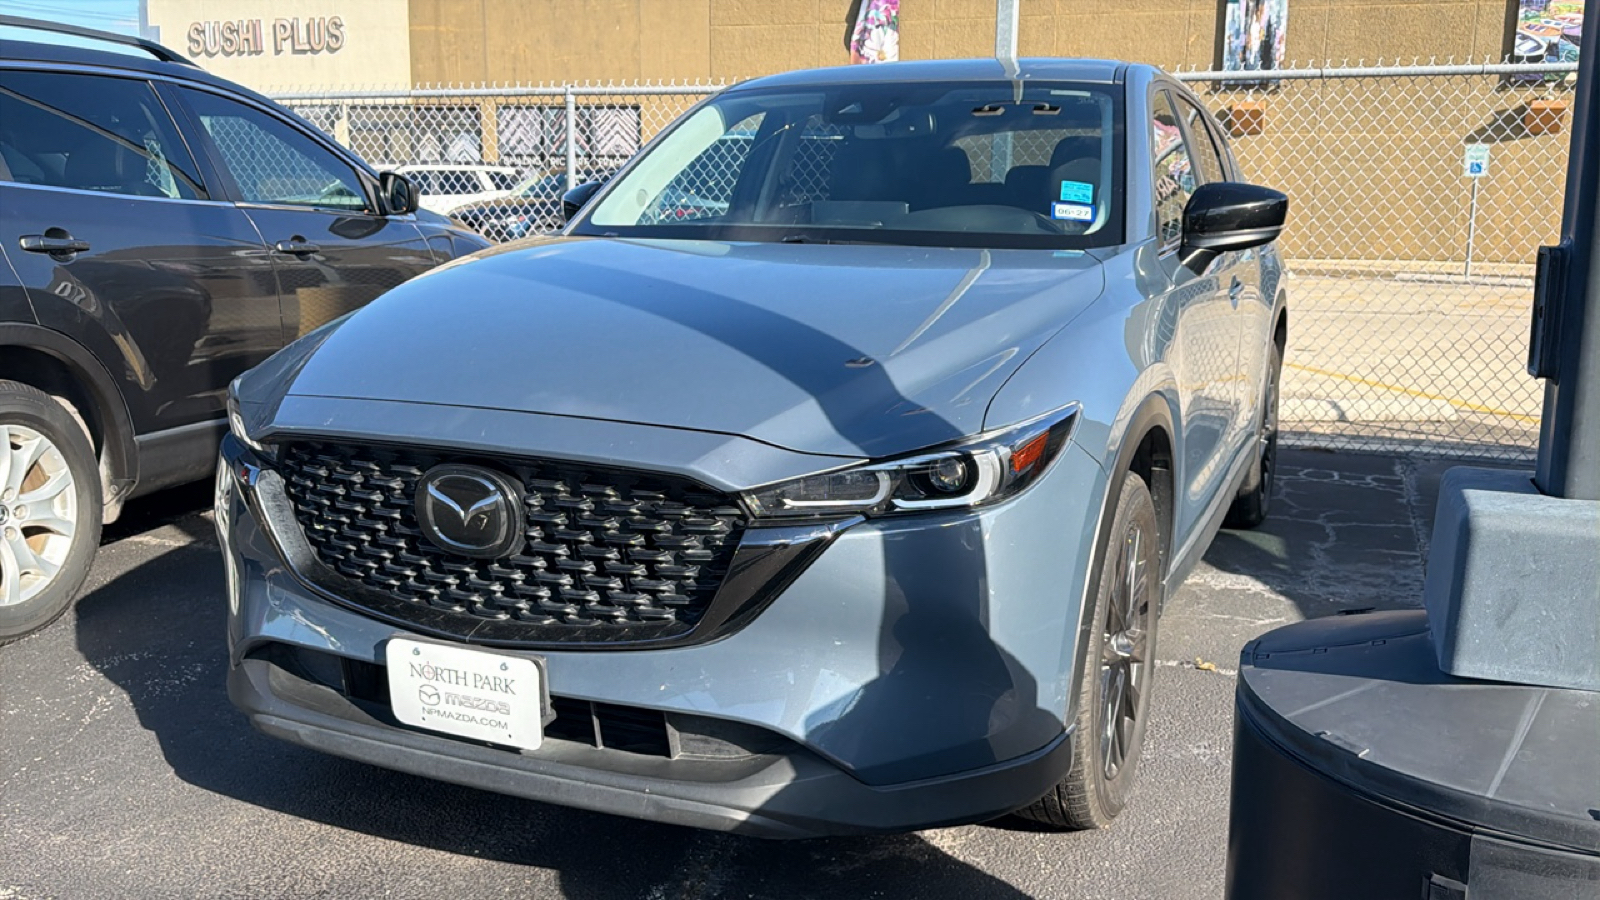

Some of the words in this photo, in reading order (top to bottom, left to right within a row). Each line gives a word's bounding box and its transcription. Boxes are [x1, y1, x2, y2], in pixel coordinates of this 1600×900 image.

[187, 19, 264, 58] SUSHI
[273, 15, 345, 56] PLUS
[409, 661, 467, 687] NORTH
[473, 672, 516, 696] PARK
[421, 707, 508, 730] NPMAZDA.COM
[444, 692, 511, 716] mazda
